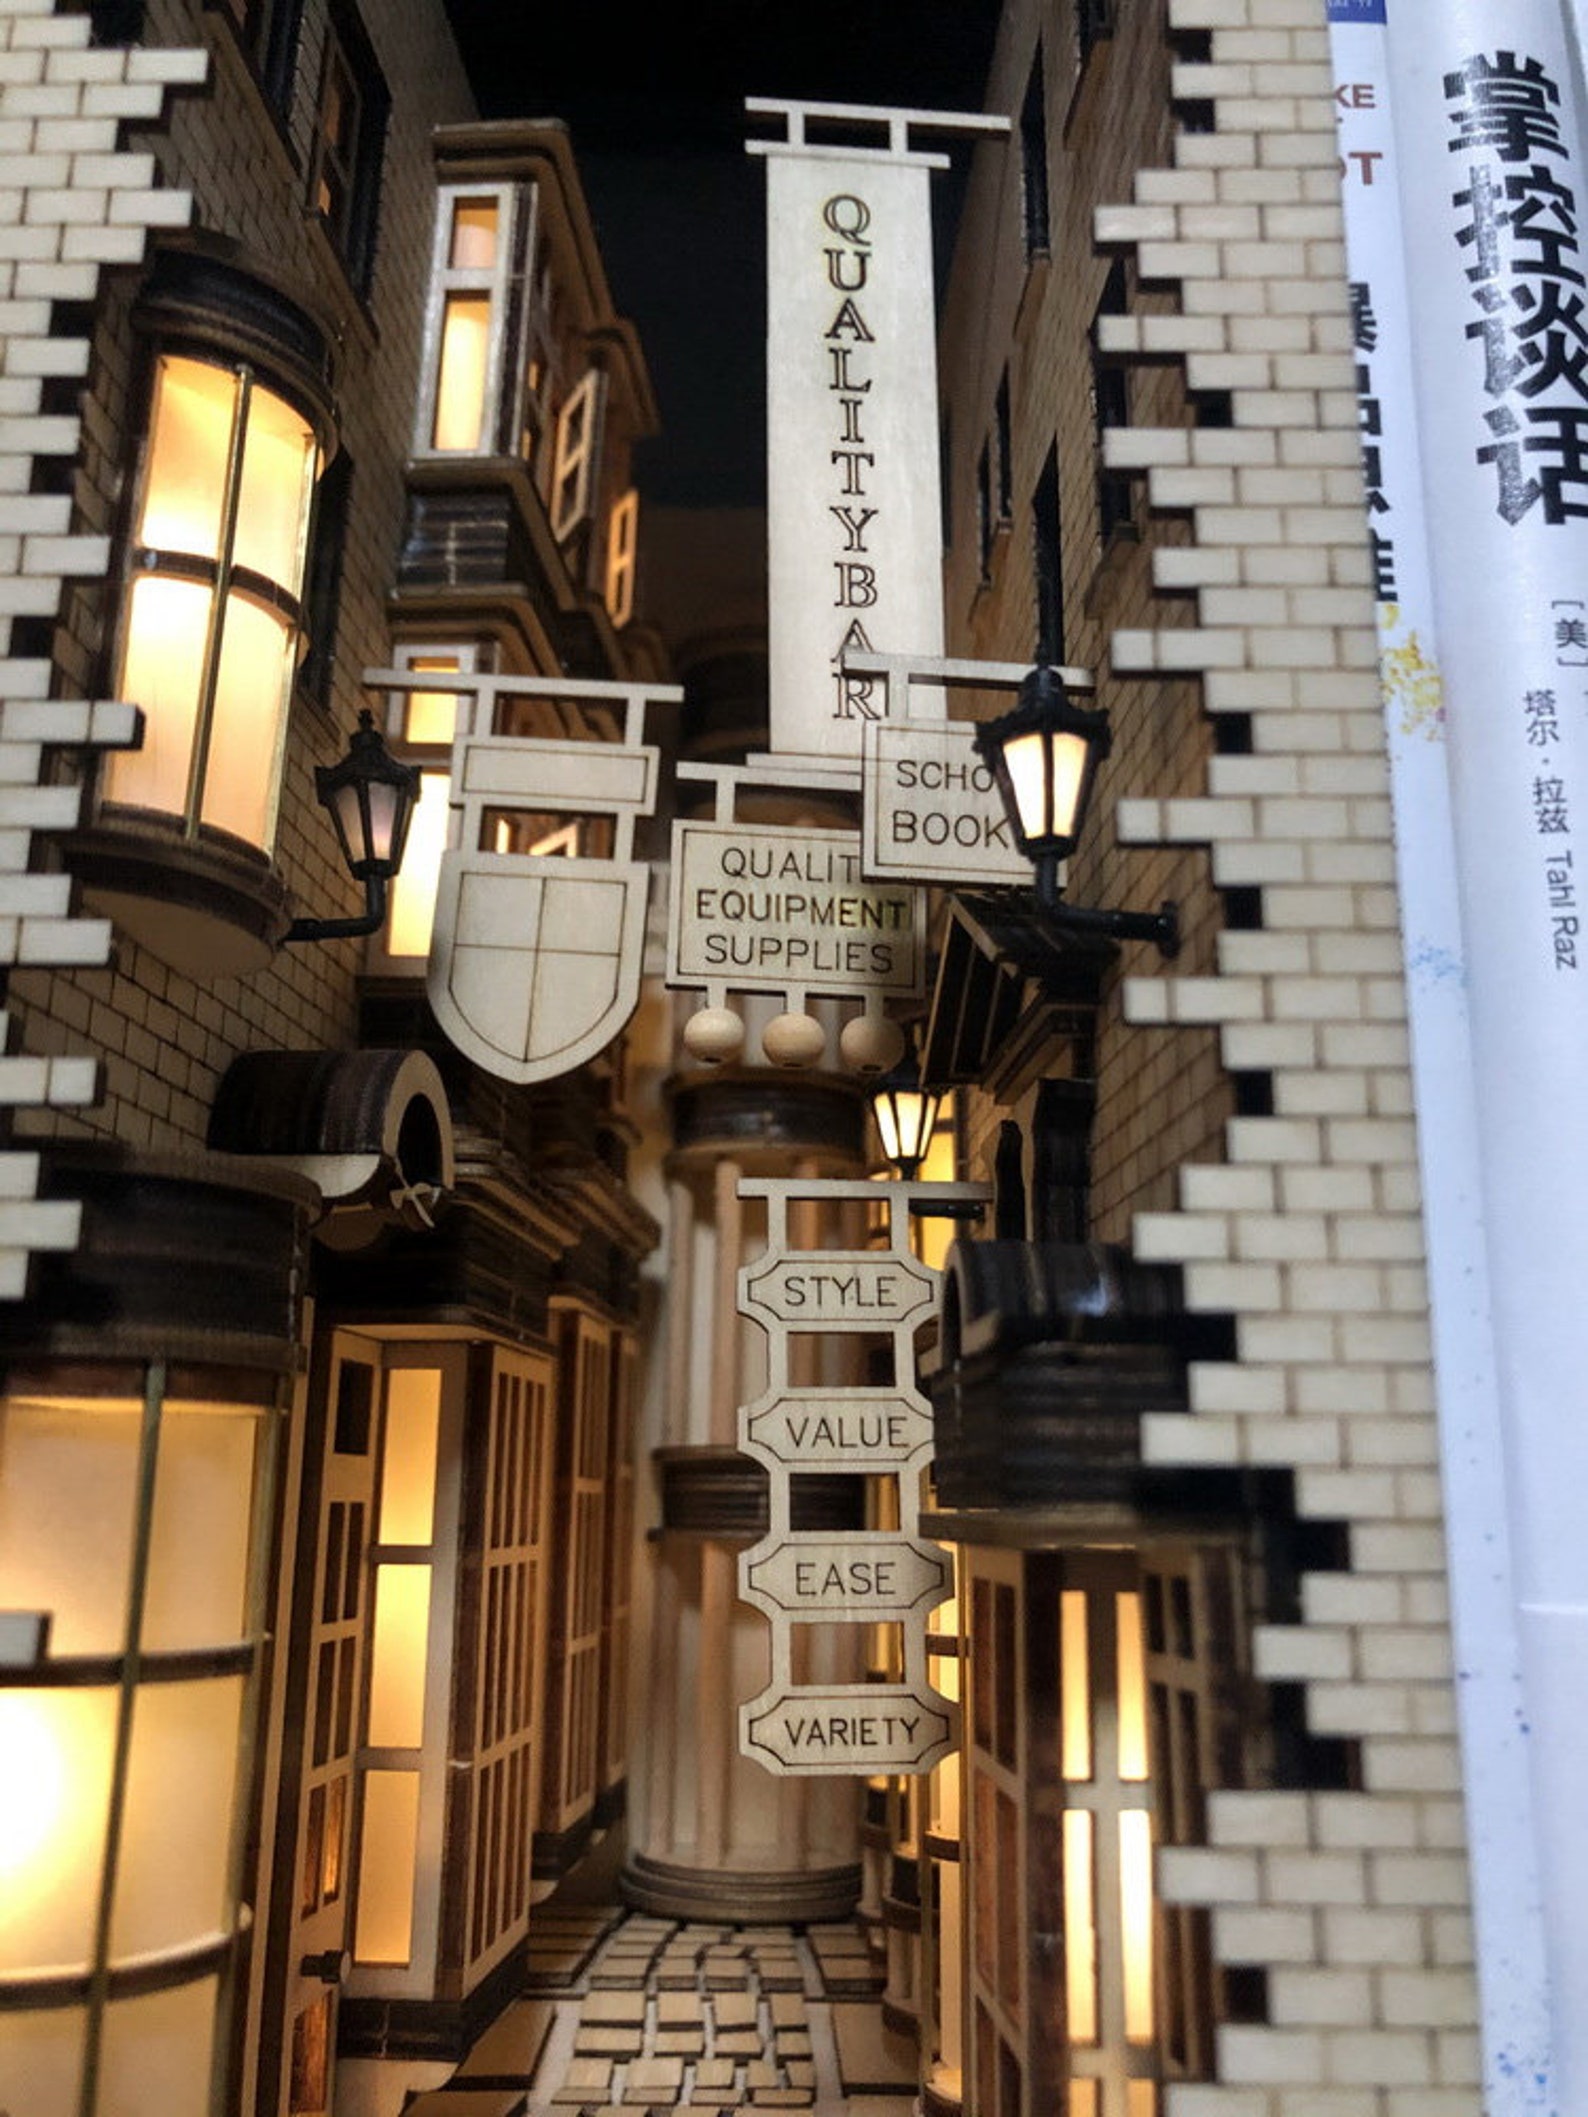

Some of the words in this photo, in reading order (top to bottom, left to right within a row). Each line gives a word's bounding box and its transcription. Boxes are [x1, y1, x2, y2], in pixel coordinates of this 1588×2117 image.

[1443, 50, 1588, 527] 掌控谈话
[896, 759, 994, 792] SCHO
[892, 810, 1011, 849] BOOK
[721, 846, 858, 884] QUALIT
[1546, 849, 1576, 908] Tahl
[696, 889, 906, 929] EQUIPMENT
[705, 934, 894, 974] SUPPLIES
[1551, 915, 1579, 971] Raz
[784, 1275, 898, 1308] STYLE
[785, 1416, 910, 1448] VALUE
[795, 1561, 897, 1595] EASE
[784, 1716, 921, 1747] VARIETY
